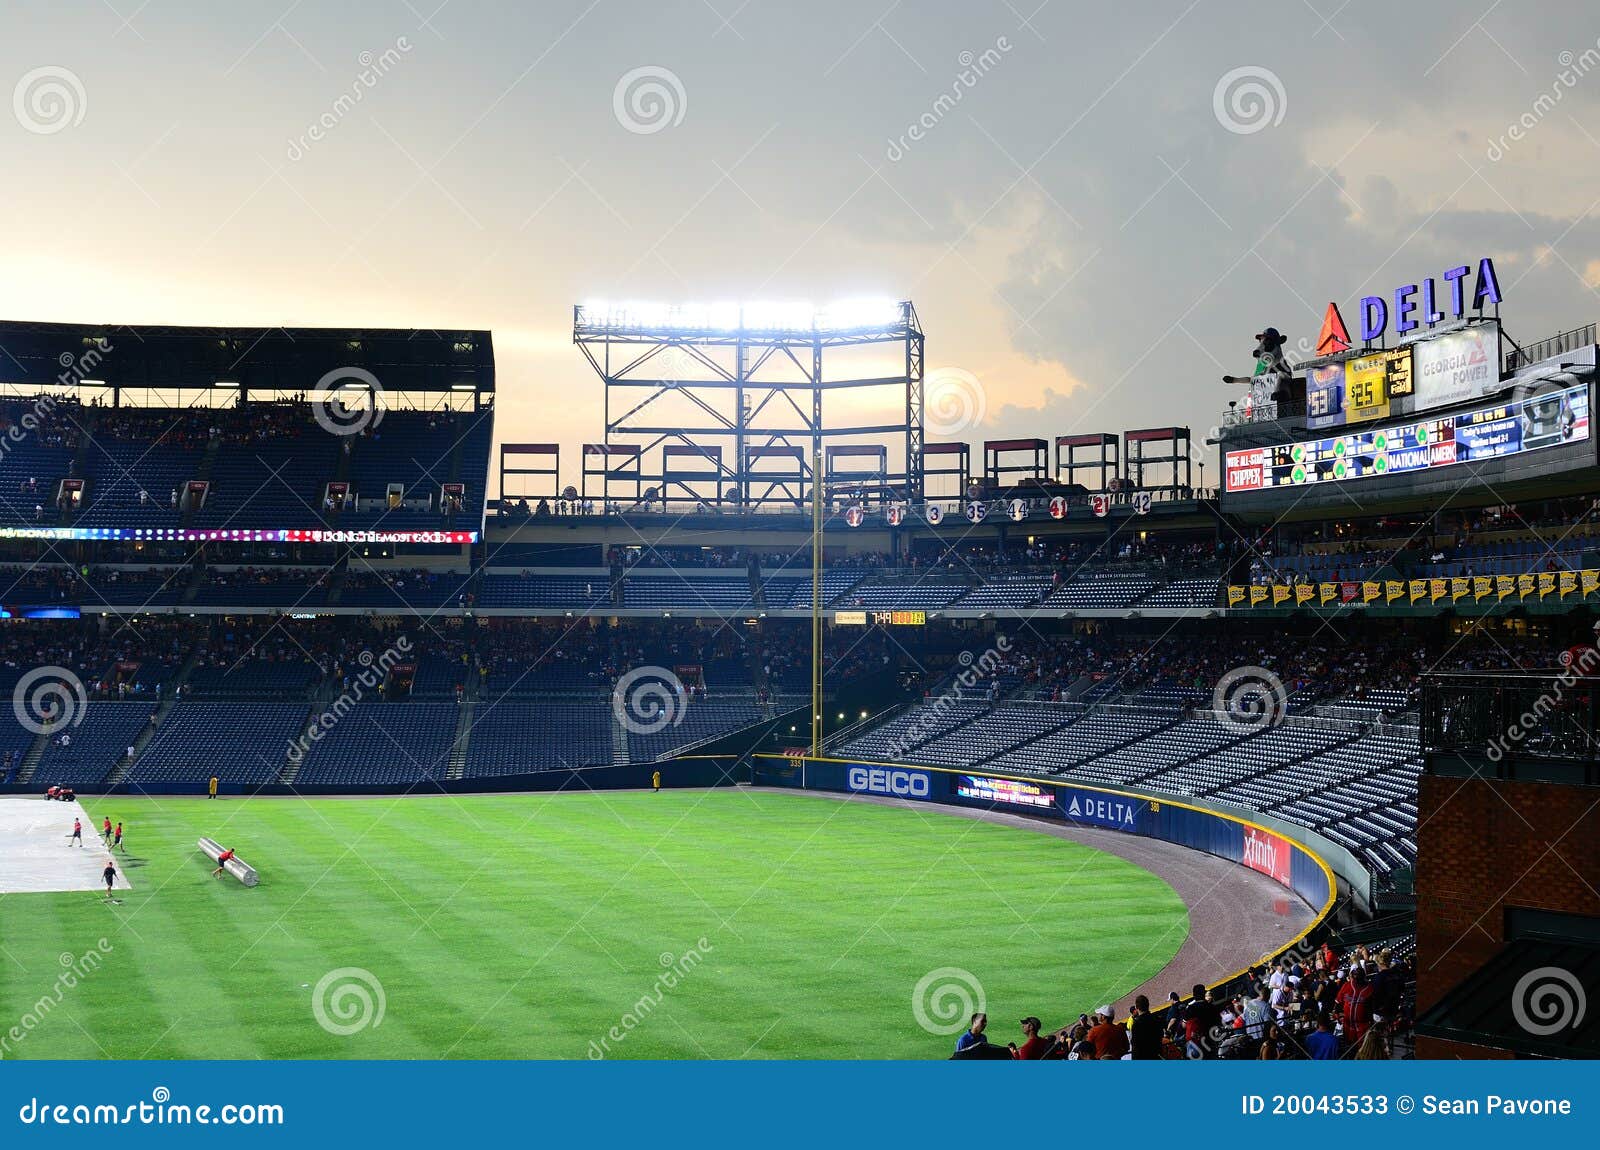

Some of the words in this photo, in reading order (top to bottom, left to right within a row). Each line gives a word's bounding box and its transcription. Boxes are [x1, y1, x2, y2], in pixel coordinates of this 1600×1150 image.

[1360, 258, 1503, 341] DELTA
[1423, 354, 1467, 376] GEORGIA
[1453, 365, 1488, 385] POWER
[1389, 449, 1429, 470] NATIONAL
[967, 504, 986, 519] 35
[1006, 501, 1029, 517] 44
[1050, 500, 1067, 517] 41
[1093, 496, 1110, 514] 21
[1133, 494, 1150, 513] 42
[930, 507, 939, 521] 3
[382, 532, 411, 542] MOST
[871, 612, 892, 624] 7:49
[849, 767, 929, 796] GEICO
[1085, 798, 1134, 825] DELTA
[1244, 829, 1277, 878] xfinity
